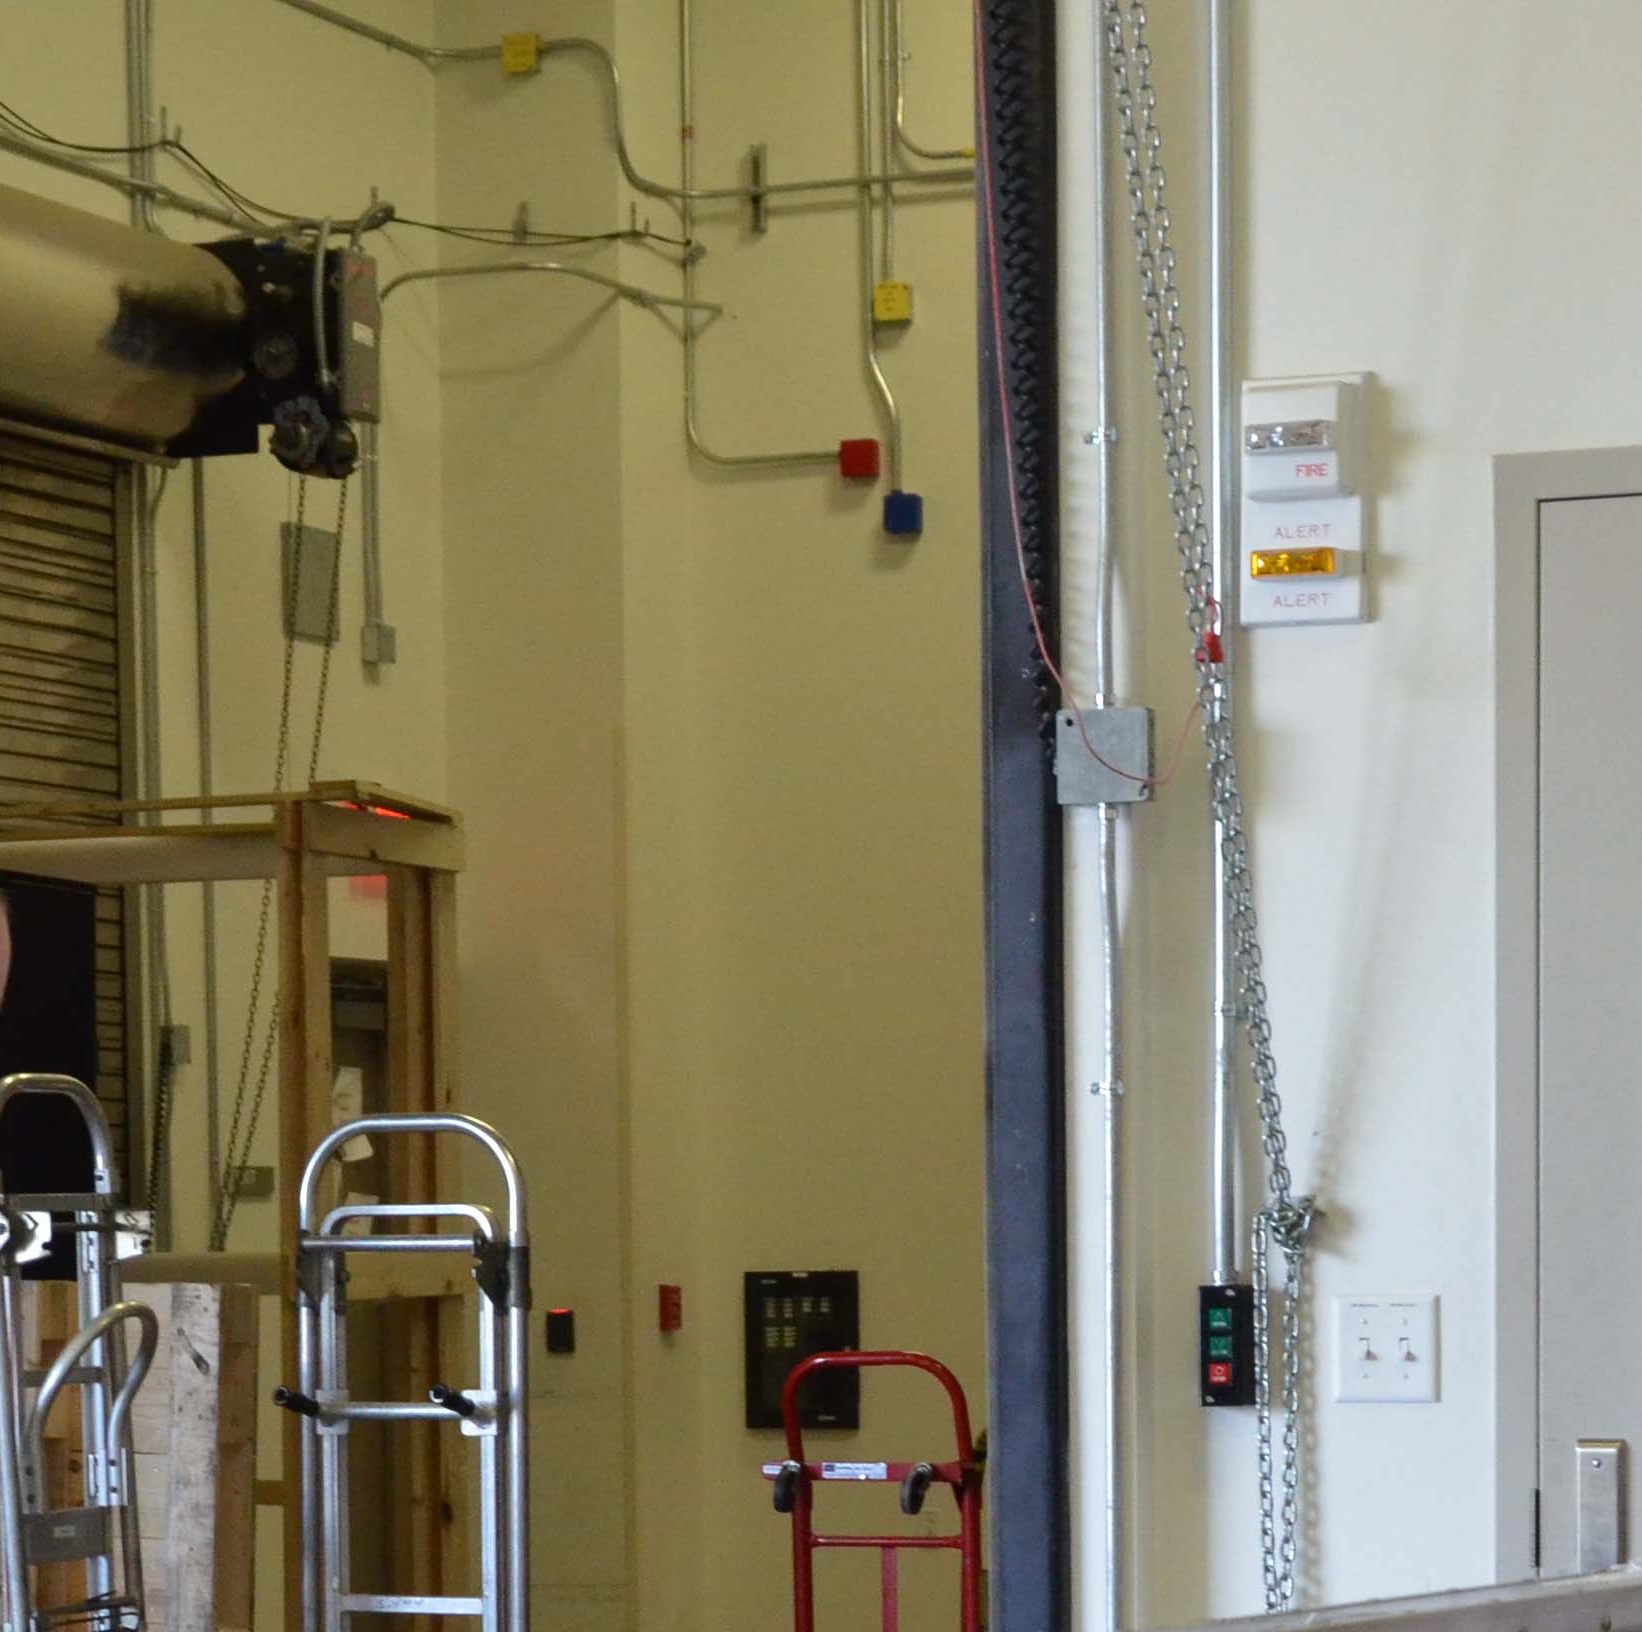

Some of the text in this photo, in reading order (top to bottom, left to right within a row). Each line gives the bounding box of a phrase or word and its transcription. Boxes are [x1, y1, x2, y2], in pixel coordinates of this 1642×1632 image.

[1295, 463, 1329, 478] FIRE
[1273, 523, 1331, 540] ALERT
[1273, 592, 1331, 608] ALERT
